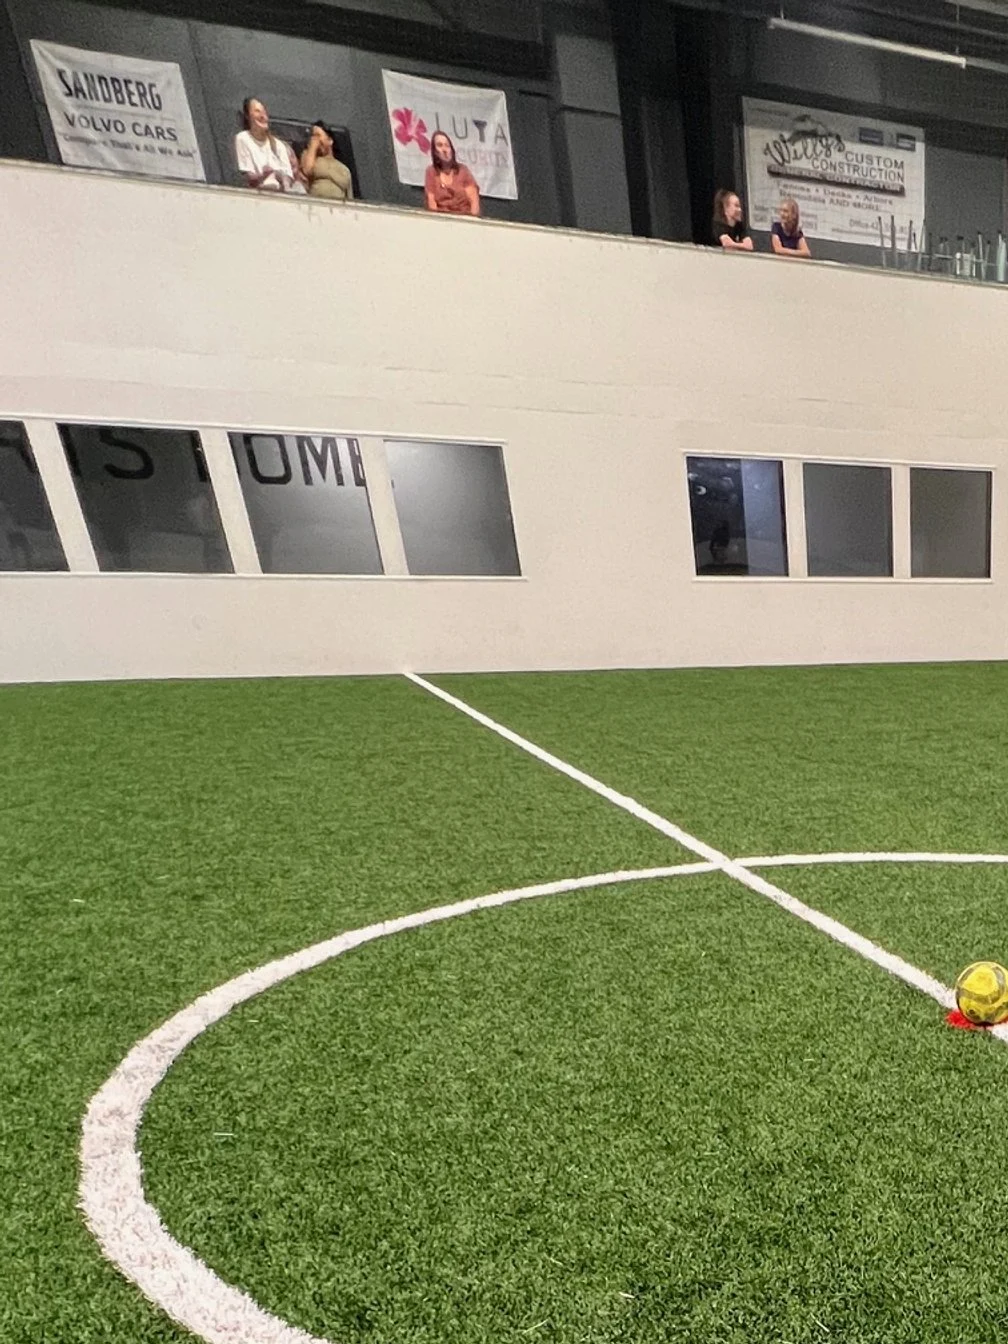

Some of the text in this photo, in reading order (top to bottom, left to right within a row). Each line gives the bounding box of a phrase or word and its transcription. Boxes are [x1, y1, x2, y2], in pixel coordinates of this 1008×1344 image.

[57, 68, 163, 111] SANDBERG
[63, 111, 178, 142] VOLVO CARS
[811, 157, 905, 182] CONSTRUCTION
[844, 151, 905, 170] CUSTOM
[828, 198, 850, 208] AND
